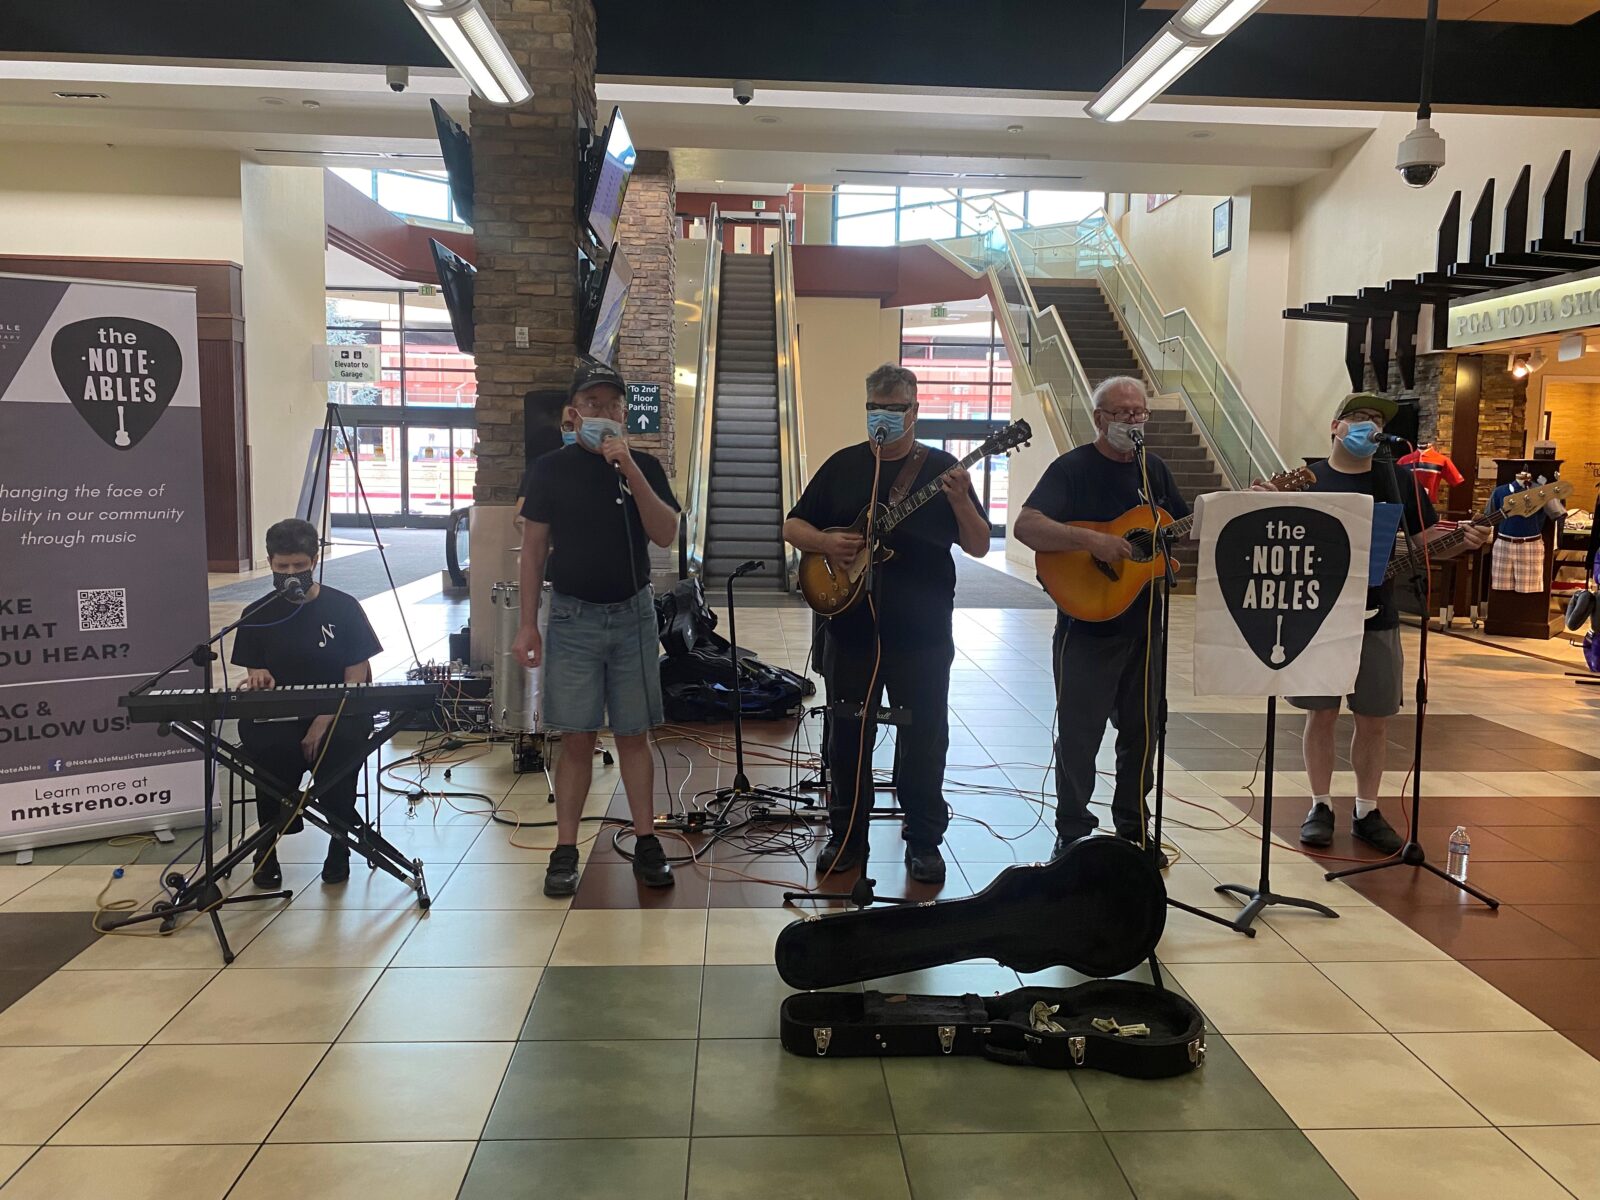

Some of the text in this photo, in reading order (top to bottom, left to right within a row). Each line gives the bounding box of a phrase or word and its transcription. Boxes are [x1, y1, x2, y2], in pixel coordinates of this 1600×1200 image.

[1455, 311, 1493, 336] PGA
[1496, 298, 1554, 329] TOUR
[98, 328, 137, 344] the
[334, 360, 360, 368] Elevator
[340, 370, 363, 379] Garage
[83, 375, 157, 403] ABLES
[630, 385, 657, 393] To 2nd
[633, 394, 654, 402] Floor
[628, 403, 659, 413] Parking
[74, 484, 101, 498] the
[106, 484, 143, 498] face
[148, 483, 166, 497] of
[1, 507, 185, 526] bility in our community
[20, 530, 137, 548] through music
[1265, 520, 1306, 540] the
[1242, 578, 1320, 611] ABLES
[43, 643, 131, 664] HEAR?
[36, 701, 52, 717] &
[93, 716, 131, 734] US!
[35, 776, 149, 801] Learn more at
[11, 789, 172, 822] nmtsreno.org
